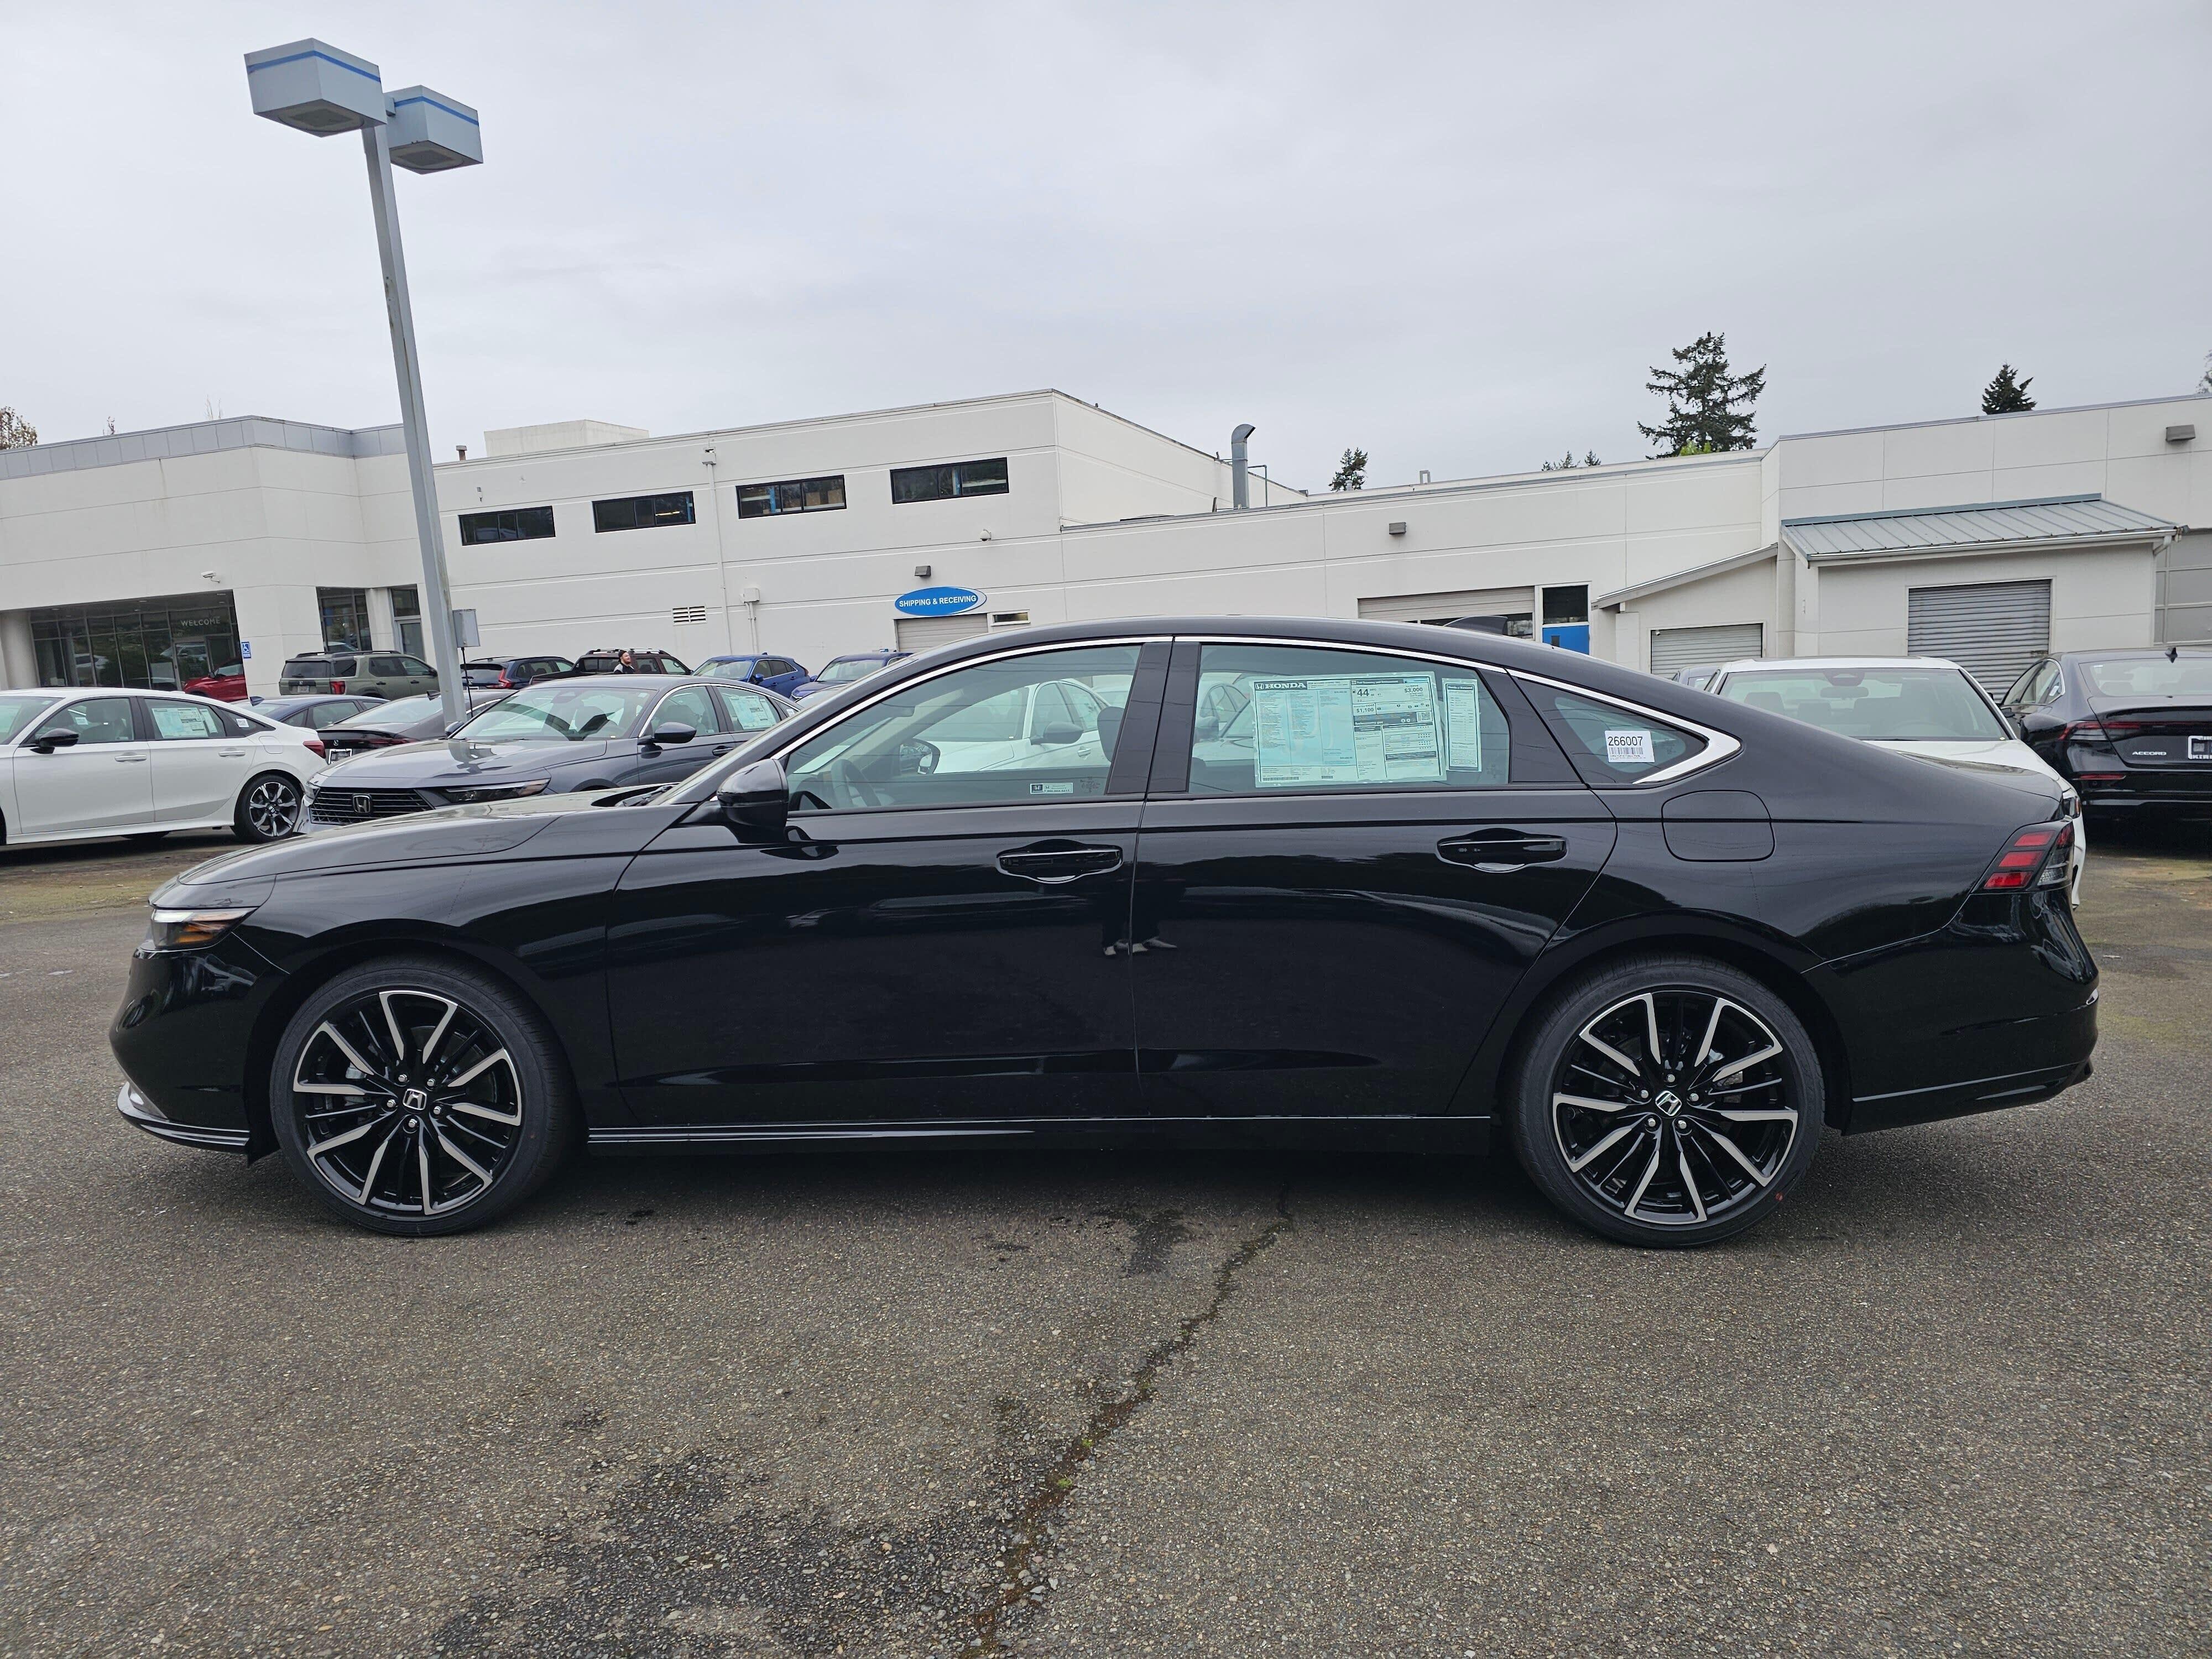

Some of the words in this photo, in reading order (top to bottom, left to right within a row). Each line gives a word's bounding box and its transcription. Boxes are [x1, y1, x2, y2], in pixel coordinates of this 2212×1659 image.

[899, 599, 931, 607] SHIPPING
[939, 596, 977, 604] RECEIVING
[181, 616, 221, 626] WELCOME
[1608, 736, 1643, 746] 266007
